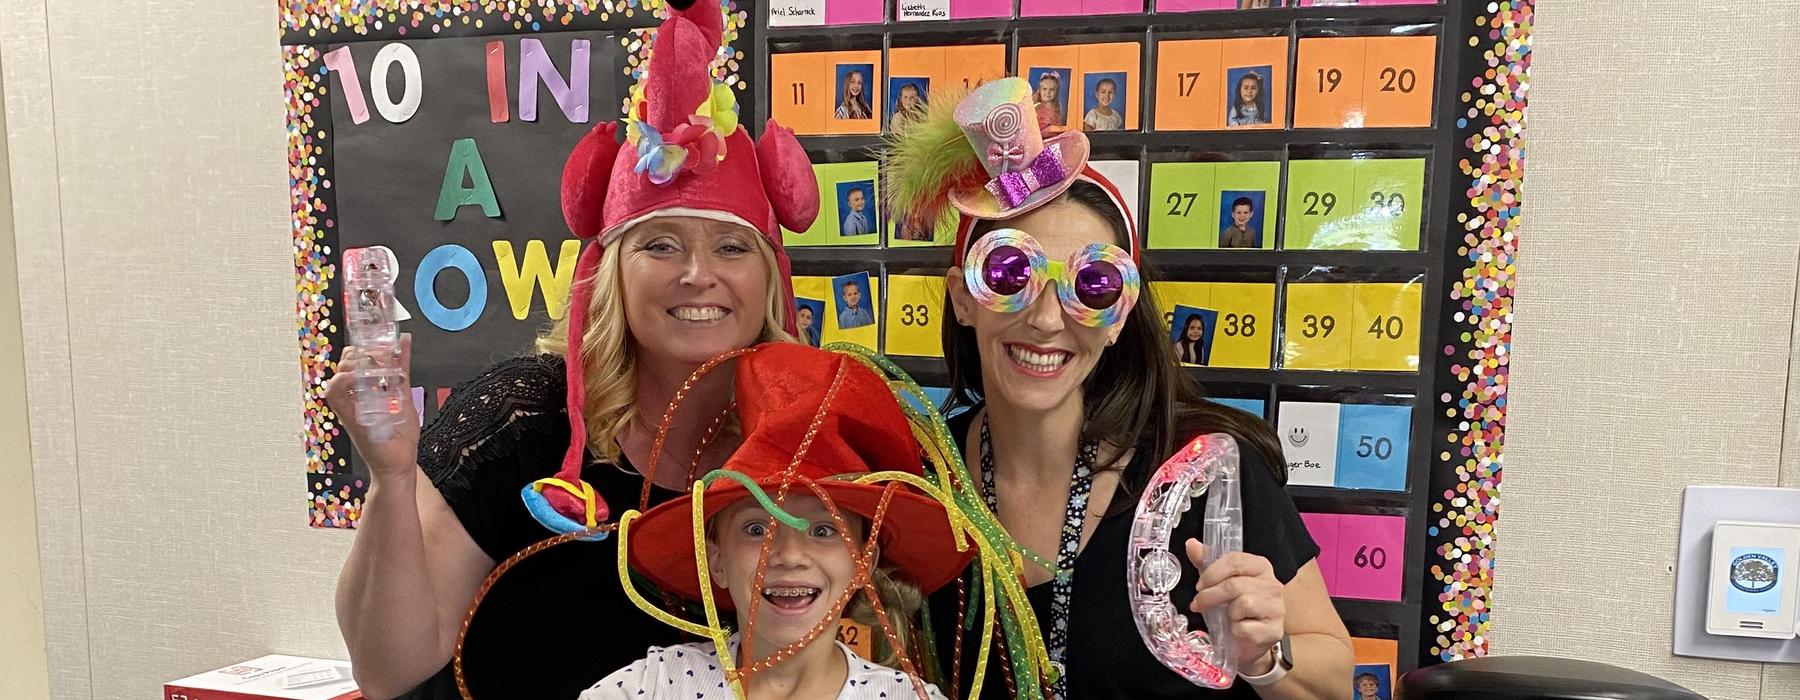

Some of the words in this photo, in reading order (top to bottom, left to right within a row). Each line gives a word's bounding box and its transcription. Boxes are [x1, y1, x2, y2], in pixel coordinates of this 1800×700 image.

[771, 7, 785, 16] Ariel
[323, 42, 422, 125] 10
[485, 38, 591, 123] IN
[1177, 72, 1200, 97] 17
[1317, 68, 1342, 93] 19
[1379, 67, 1416, 93] 20
[792, 82, 805, 105] 11
[434, 138, 501, 220] A
[1166, 192, 1198, 217] 27
[1303, 191, 1337, 216] 29
[901, 303, 929, 327] 33
[1223, 313, 1256, 337] 38
[1302, 314, 1335, 338] 39
[1367, 315, 1403, 340] 40
[1356, 436, 1392, 460] 50
[1304, 460, 1321, 469] Boe
[1353, 545, 1387, 570] 60
[1757, 555, 1777, 569] VALLEY
[835, 625, 858, 645] 62
